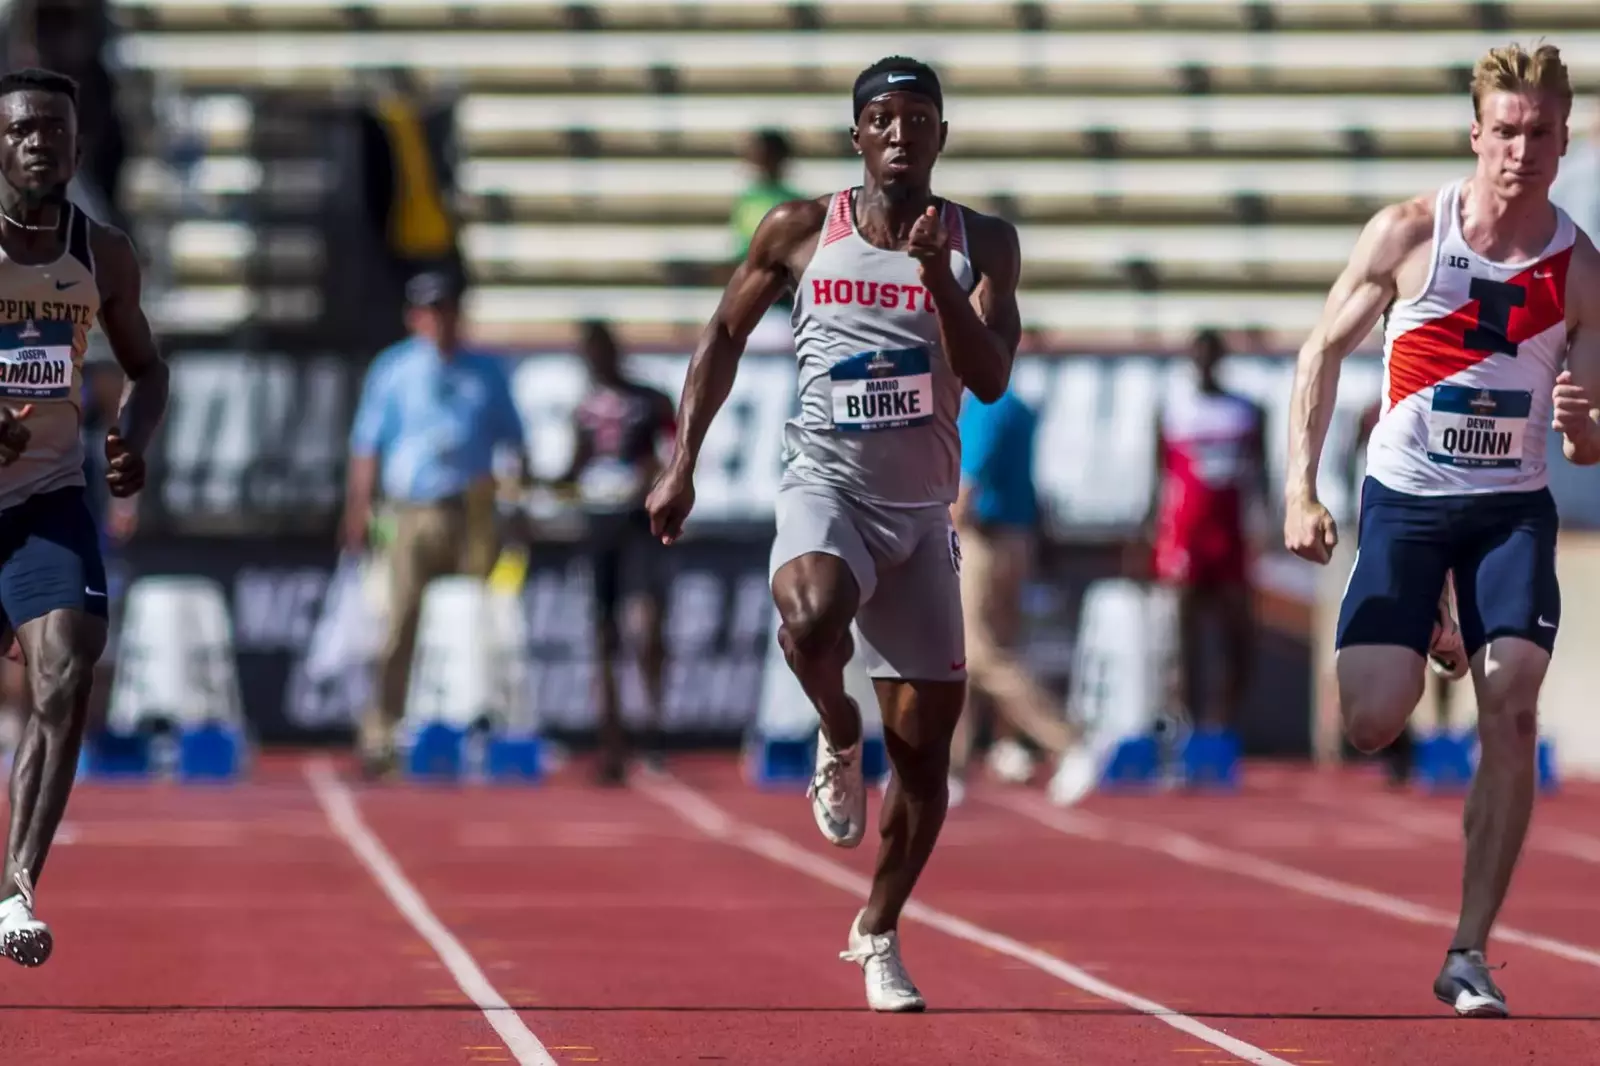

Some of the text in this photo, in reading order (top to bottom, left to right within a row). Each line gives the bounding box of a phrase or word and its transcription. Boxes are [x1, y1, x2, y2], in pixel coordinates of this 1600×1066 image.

[41, 302, 90, 324] STATE
[16, 349, 47, 361] JOSEPH
[0, 360, 65, 385] AMOAH
[866, 380, 899, 392] MARIO
[846, 390, 921, 419] BURKE
[1466, 417, 1496, 430] DEVIN
[1442, 427, 1513, 455] QUINN
